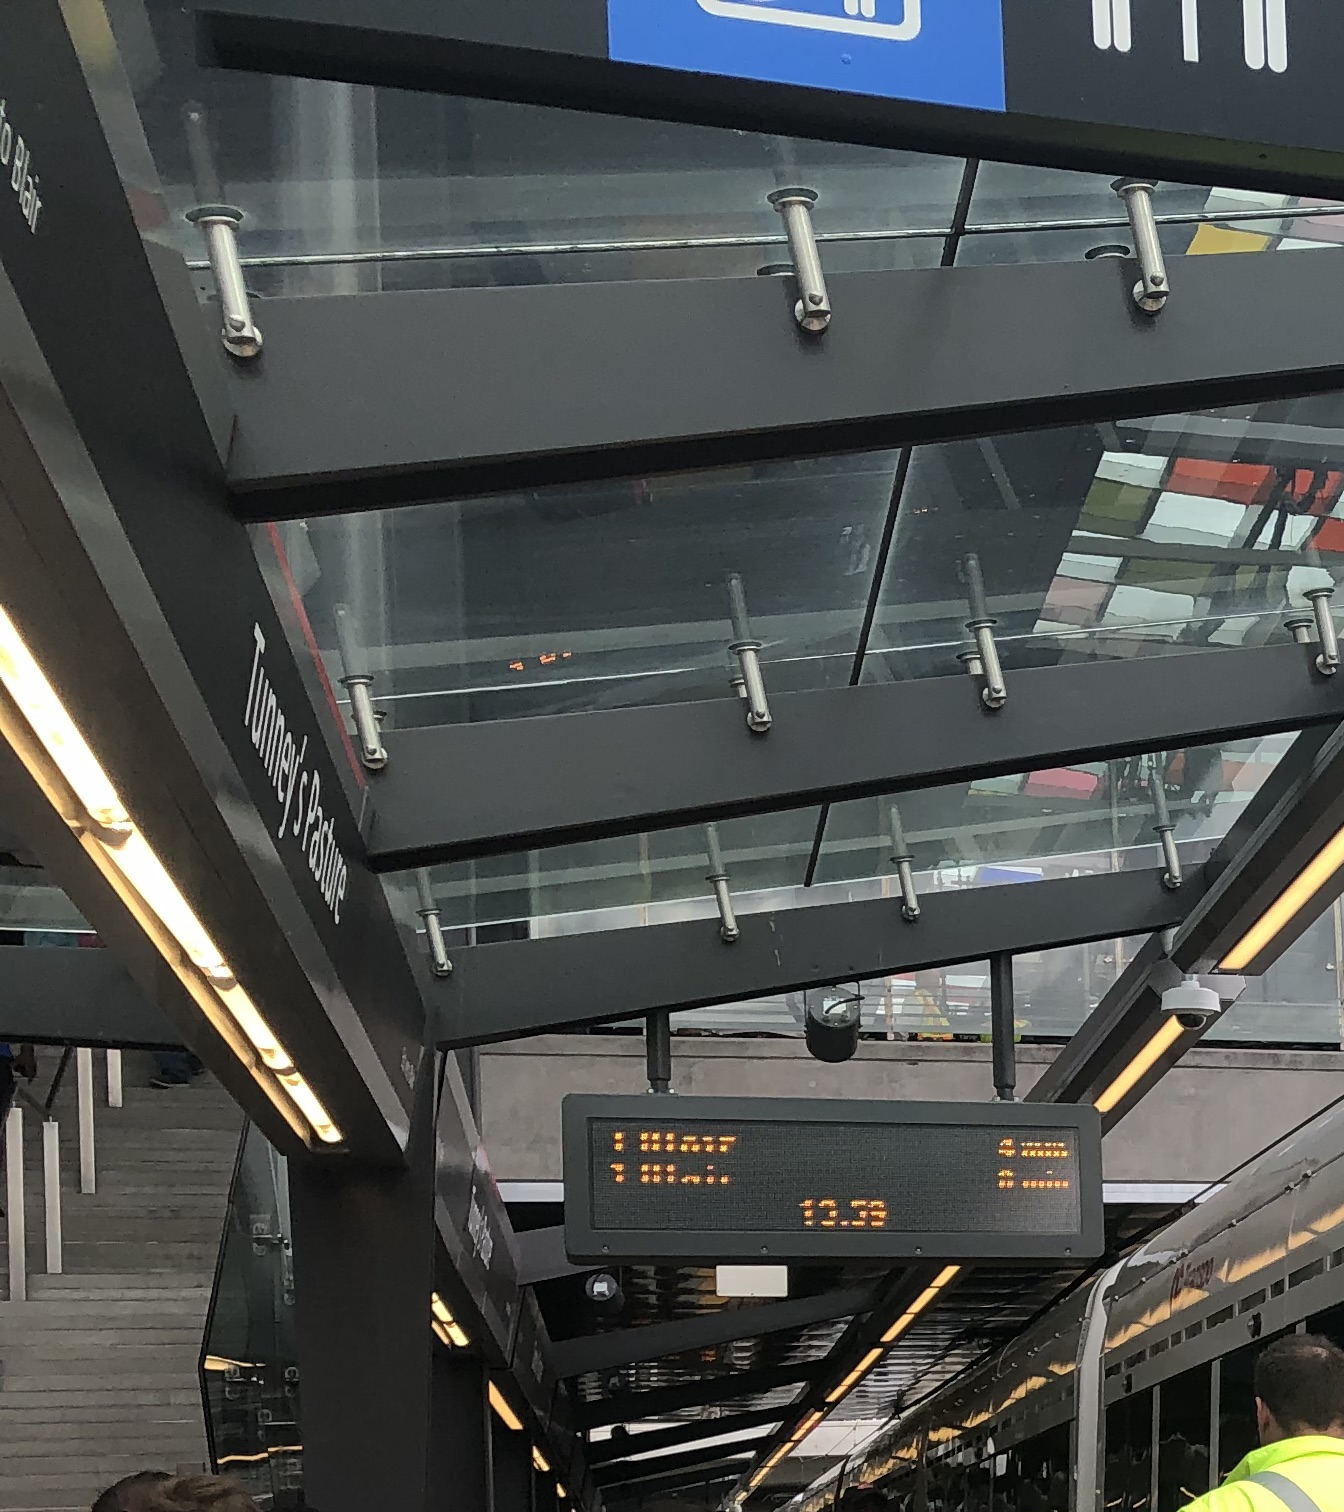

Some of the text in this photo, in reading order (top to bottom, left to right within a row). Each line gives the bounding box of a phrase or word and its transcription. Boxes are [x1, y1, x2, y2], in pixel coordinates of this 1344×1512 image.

[11, 134, 43, 235] Blair
[244, 621, 347, 925] Tunney's Pasture
